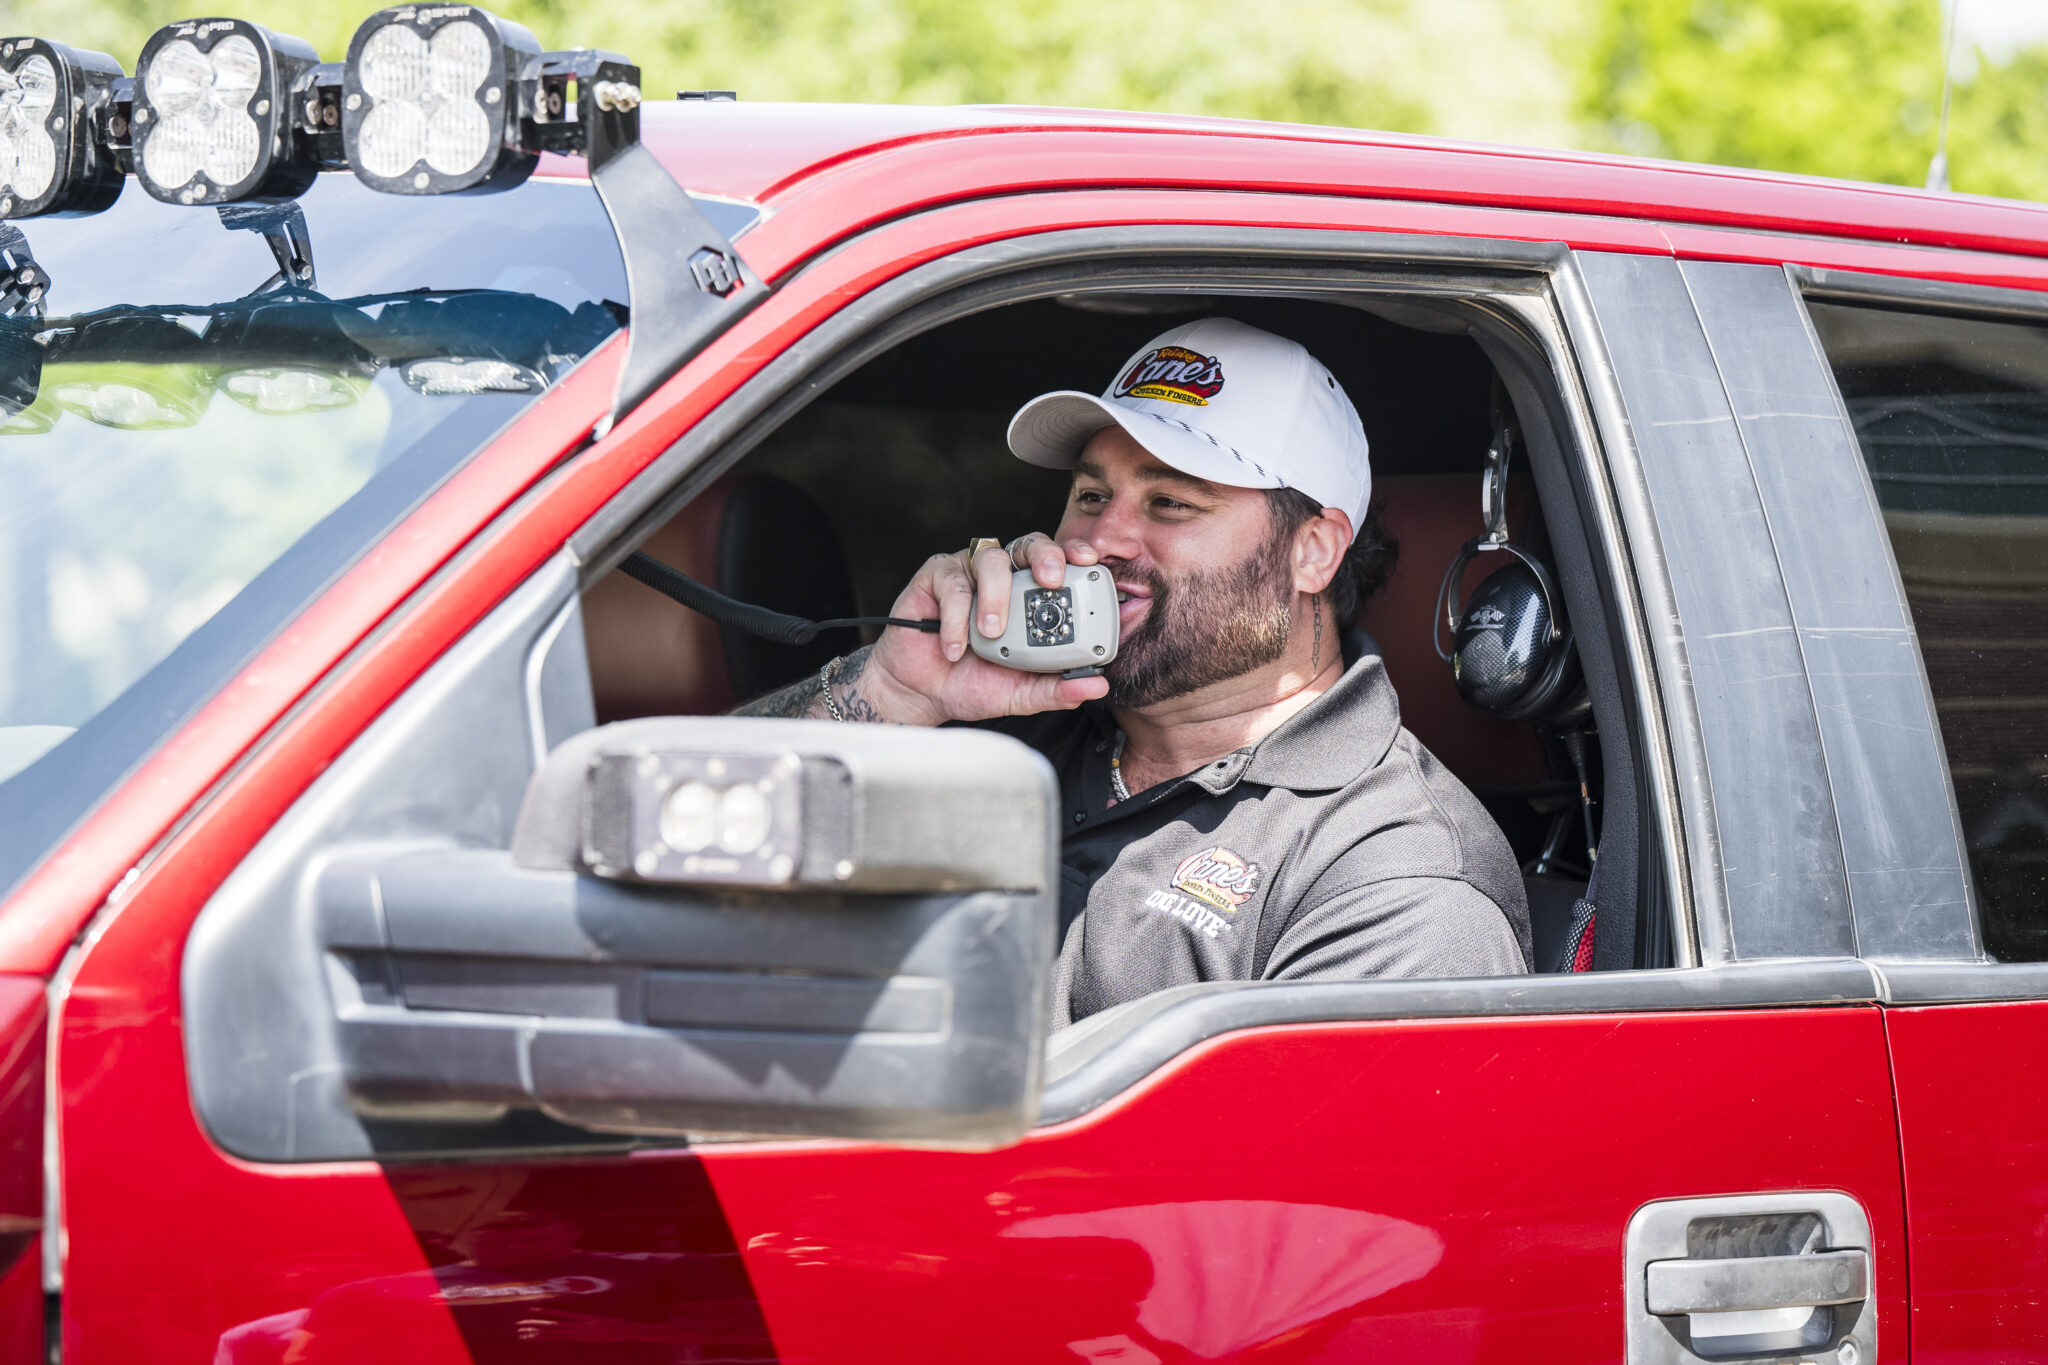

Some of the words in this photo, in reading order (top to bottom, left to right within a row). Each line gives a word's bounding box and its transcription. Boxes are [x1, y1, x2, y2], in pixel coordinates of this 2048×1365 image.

[208, 20, 235, 32] PRO
[1114, 349, 1224, 397] Cane's
[1166, 389, 1203, 406] FINGERS
[1170, 847, 1258, 895] Cane's
[1170, 897, 1227, 938] LOVE
